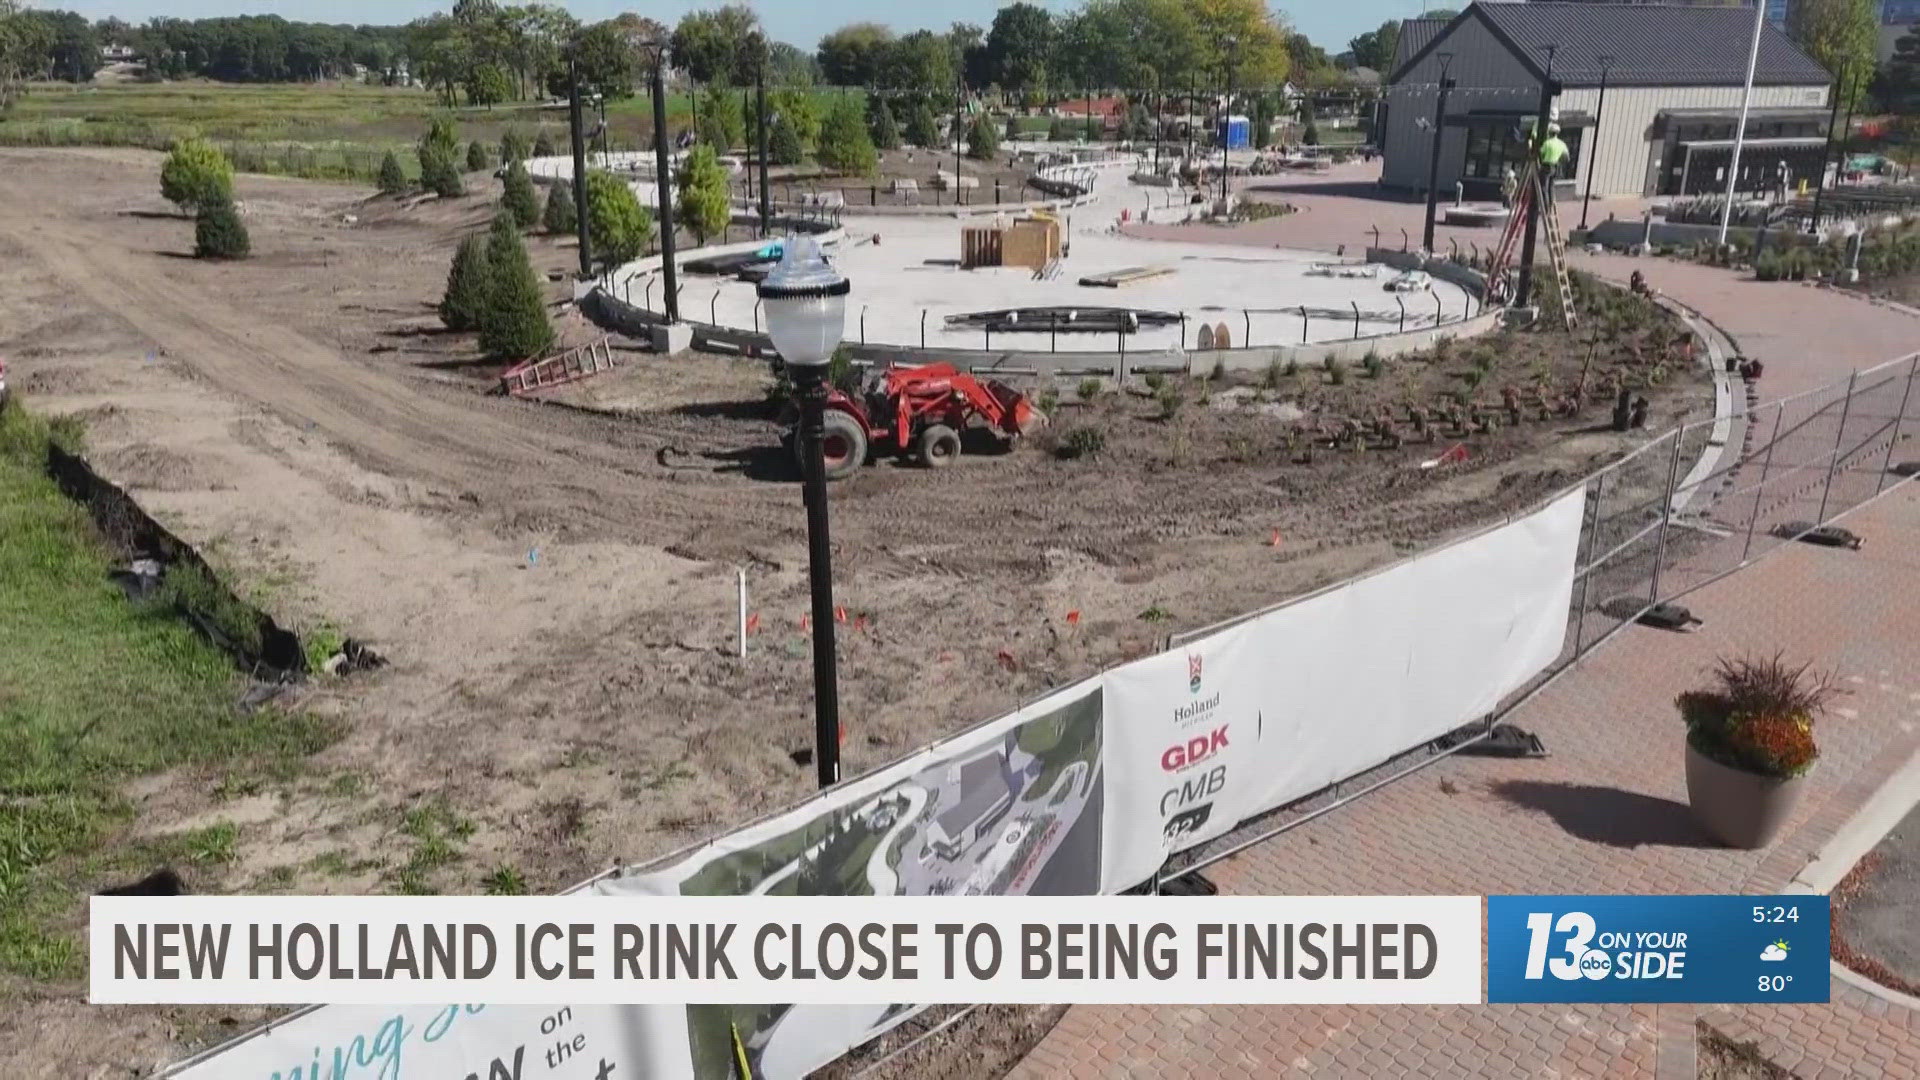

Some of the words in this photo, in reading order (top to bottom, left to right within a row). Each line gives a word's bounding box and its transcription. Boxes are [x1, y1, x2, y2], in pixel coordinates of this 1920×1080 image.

[1174, 691, 1220, 722] Holland
[1161, 723, 1230, 771] GDK
[540, 1005, 572, 1035] on
[545, 1033, 586, 1069] the
